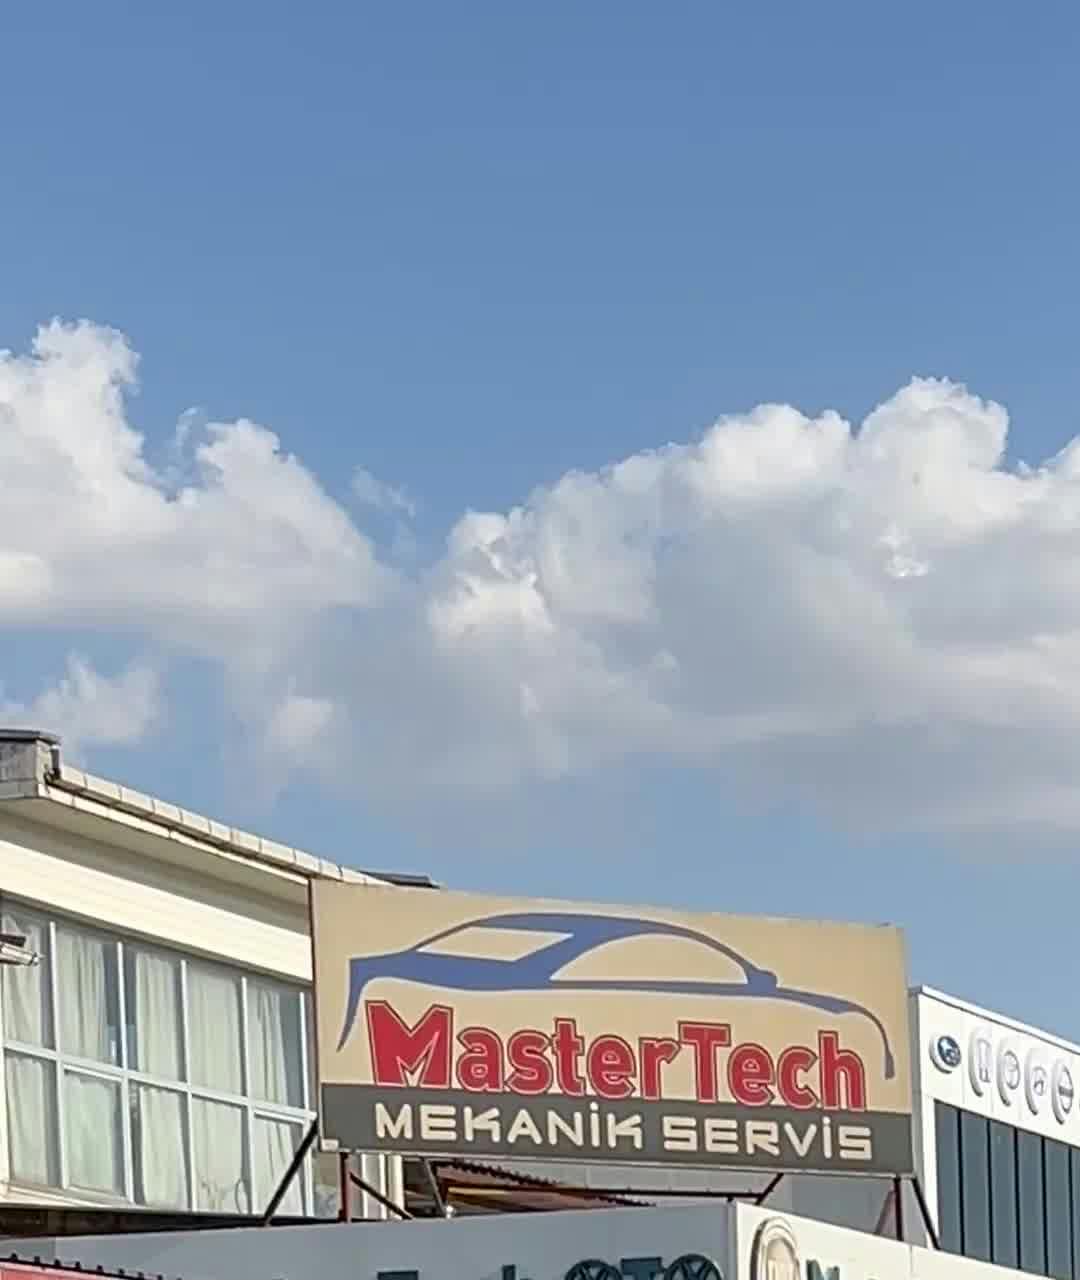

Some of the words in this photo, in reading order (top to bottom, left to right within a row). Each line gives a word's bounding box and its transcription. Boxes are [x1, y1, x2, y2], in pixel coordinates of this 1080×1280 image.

[365, 1000, 867, 1111] MasterTech
[375, 1102, 643, 1150] MEKANİK
[663, 1115, 872, 1160] SERVİS
